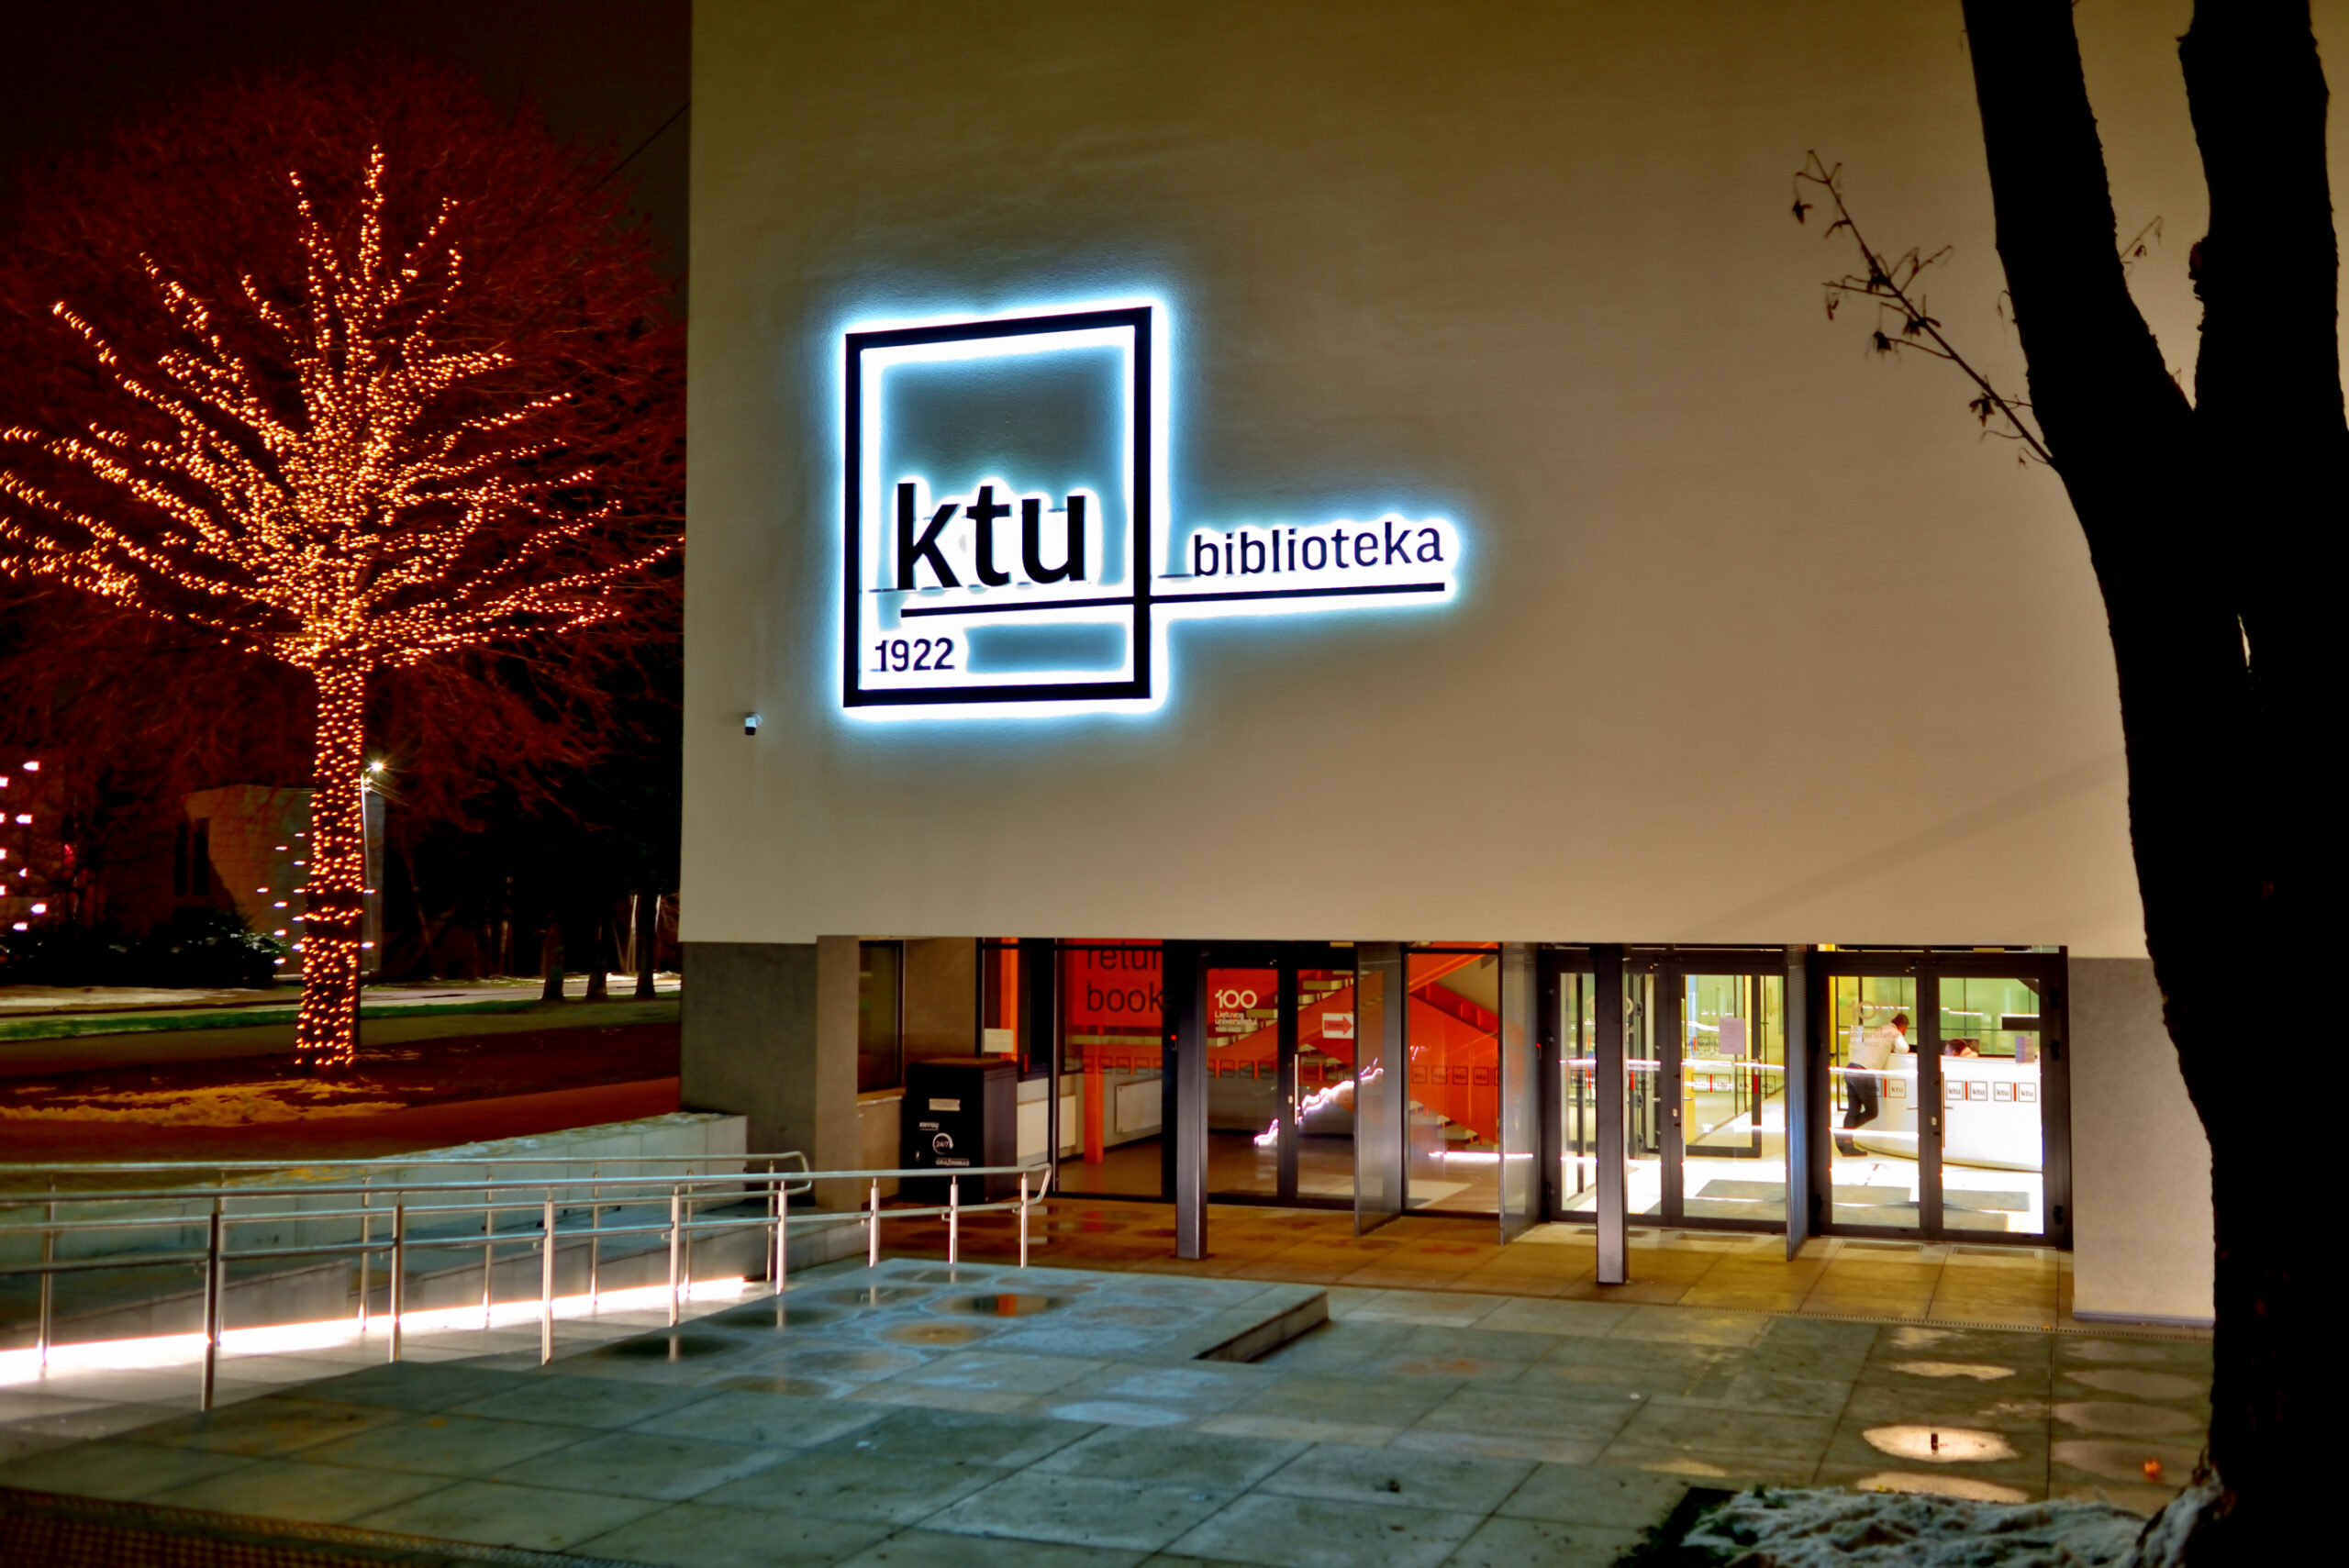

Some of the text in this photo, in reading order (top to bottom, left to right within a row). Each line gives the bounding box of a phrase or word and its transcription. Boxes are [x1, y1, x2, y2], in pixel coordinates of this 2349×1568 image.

[896, 482, 1087, 591] ktu
[1193, 519, 1444, 577] biblioteka
[874, 637, 955, 673] 1922
[1214, 989, 1258, 1009] 100
[935, 1140, 950, 1148] 24/7
